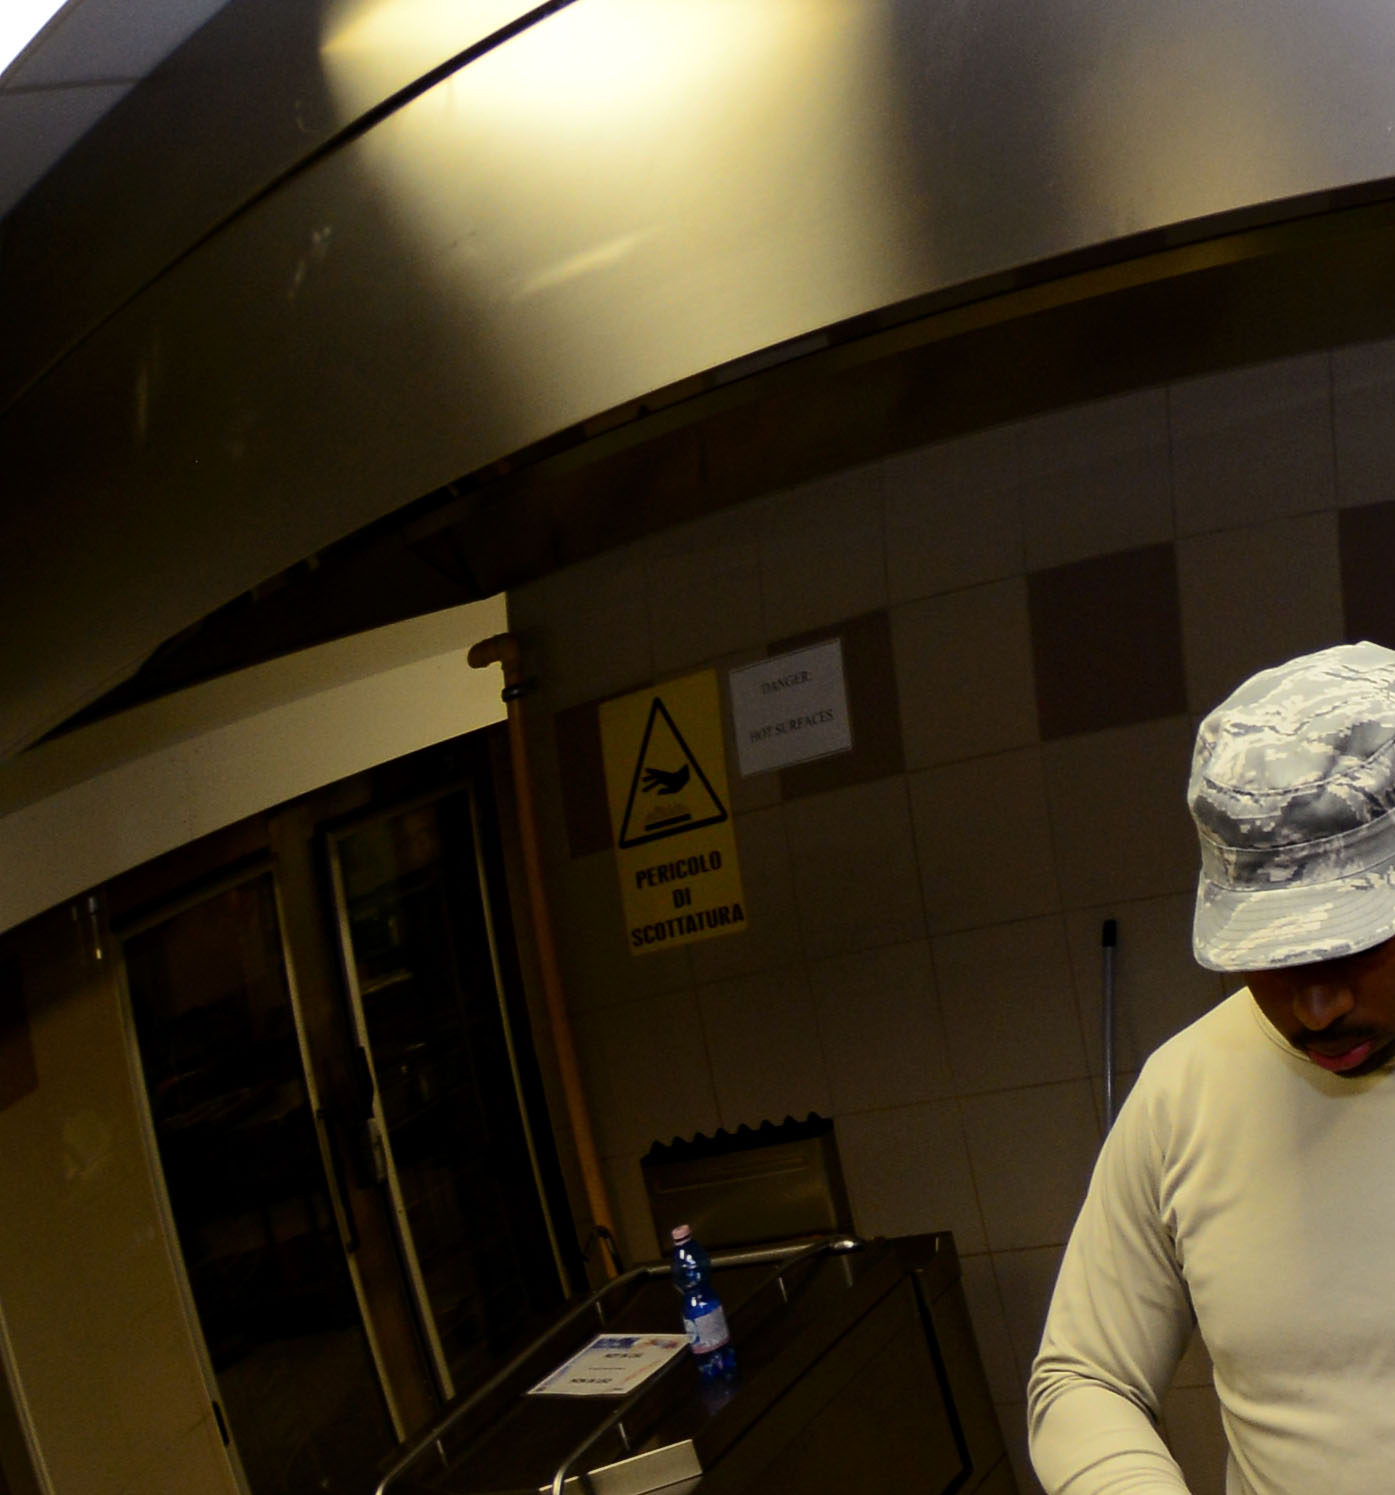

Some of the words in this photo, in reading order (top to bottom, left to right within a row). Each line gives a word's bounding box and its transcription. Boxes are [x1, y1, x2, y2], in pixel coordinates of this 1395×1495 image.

[750, 724, 772, 743] HOT
[775, 708, 834, 736] SURFACES
[635, 850, 722, 889] PERICOLO
[672, 887, 692, 909] DI
[631, 903, 744, 947] SCOTTATURA
